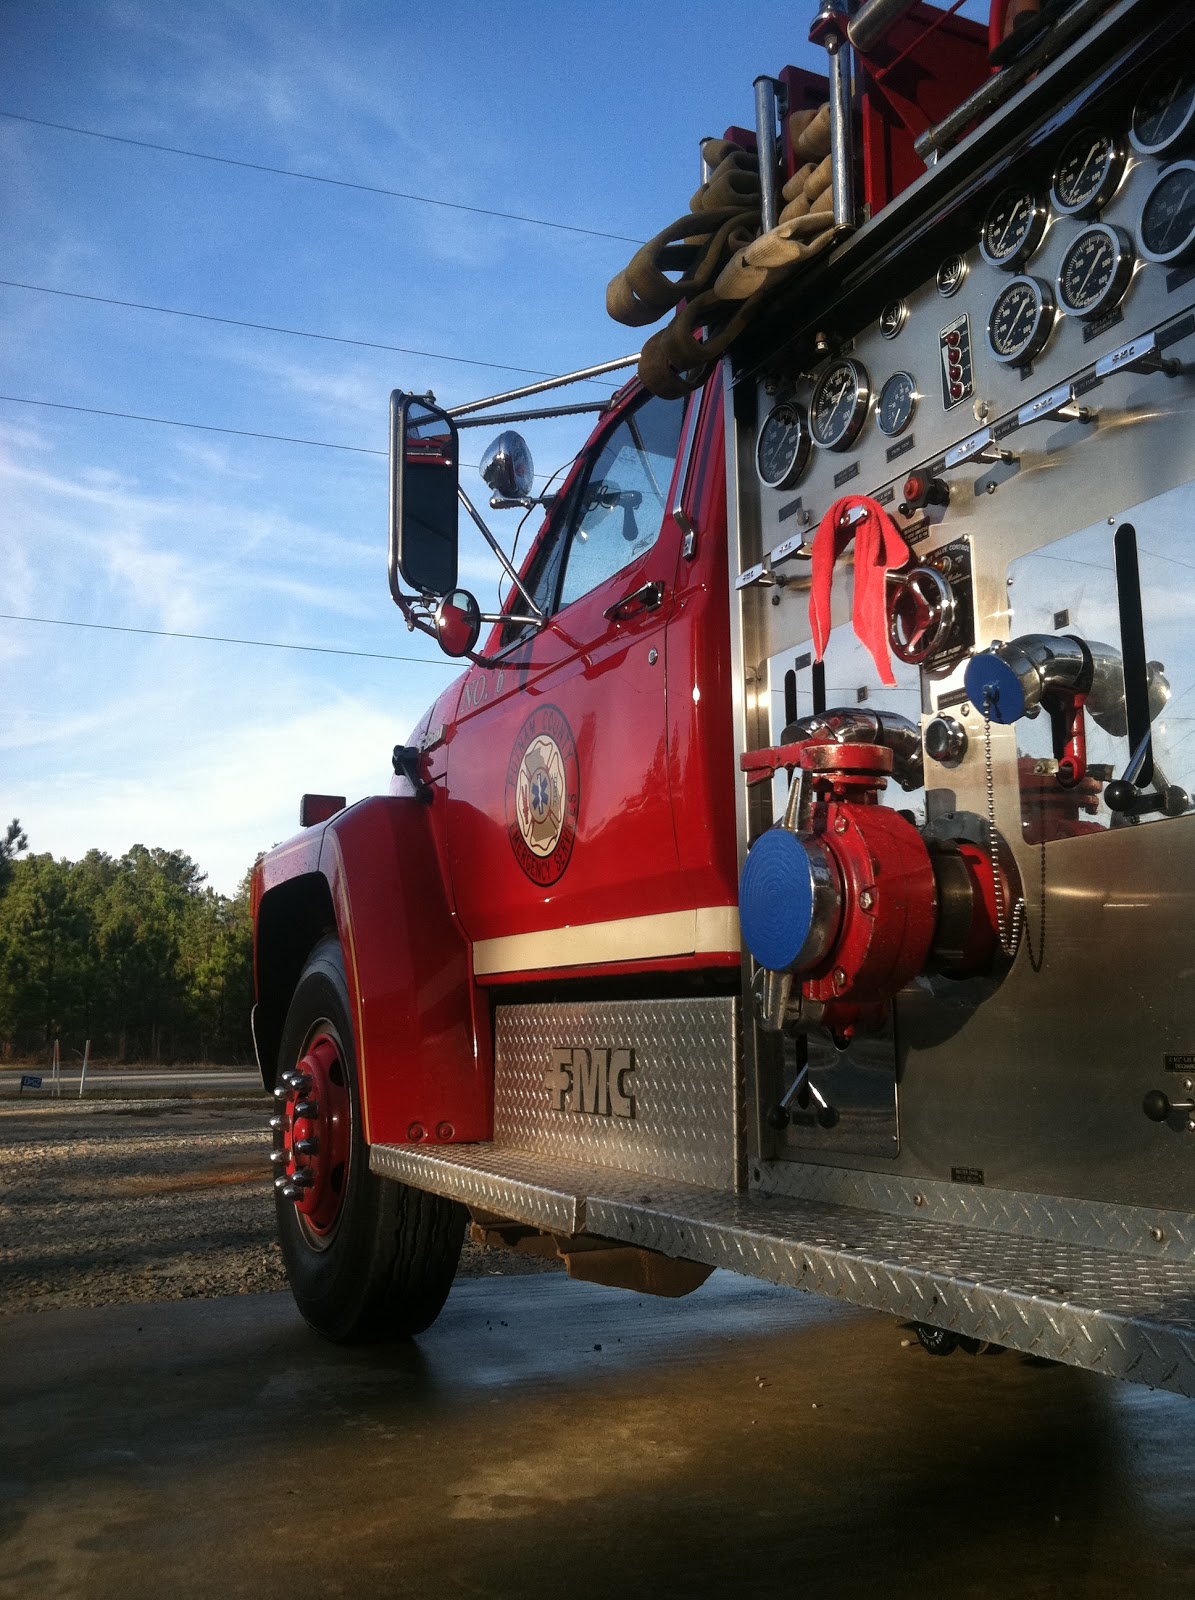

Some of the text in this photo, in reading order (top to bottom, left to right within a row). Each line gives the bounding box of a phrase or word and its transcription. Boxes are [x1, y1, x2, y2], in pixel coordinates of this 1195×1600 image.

[1112, 346, 1135, 364] FMC
[507, 710, 573, 787] PUTNAM COUNTY
[508, 821, 551, 881] EMERGENCY
[544, 1048, 636, 1119] FMC
